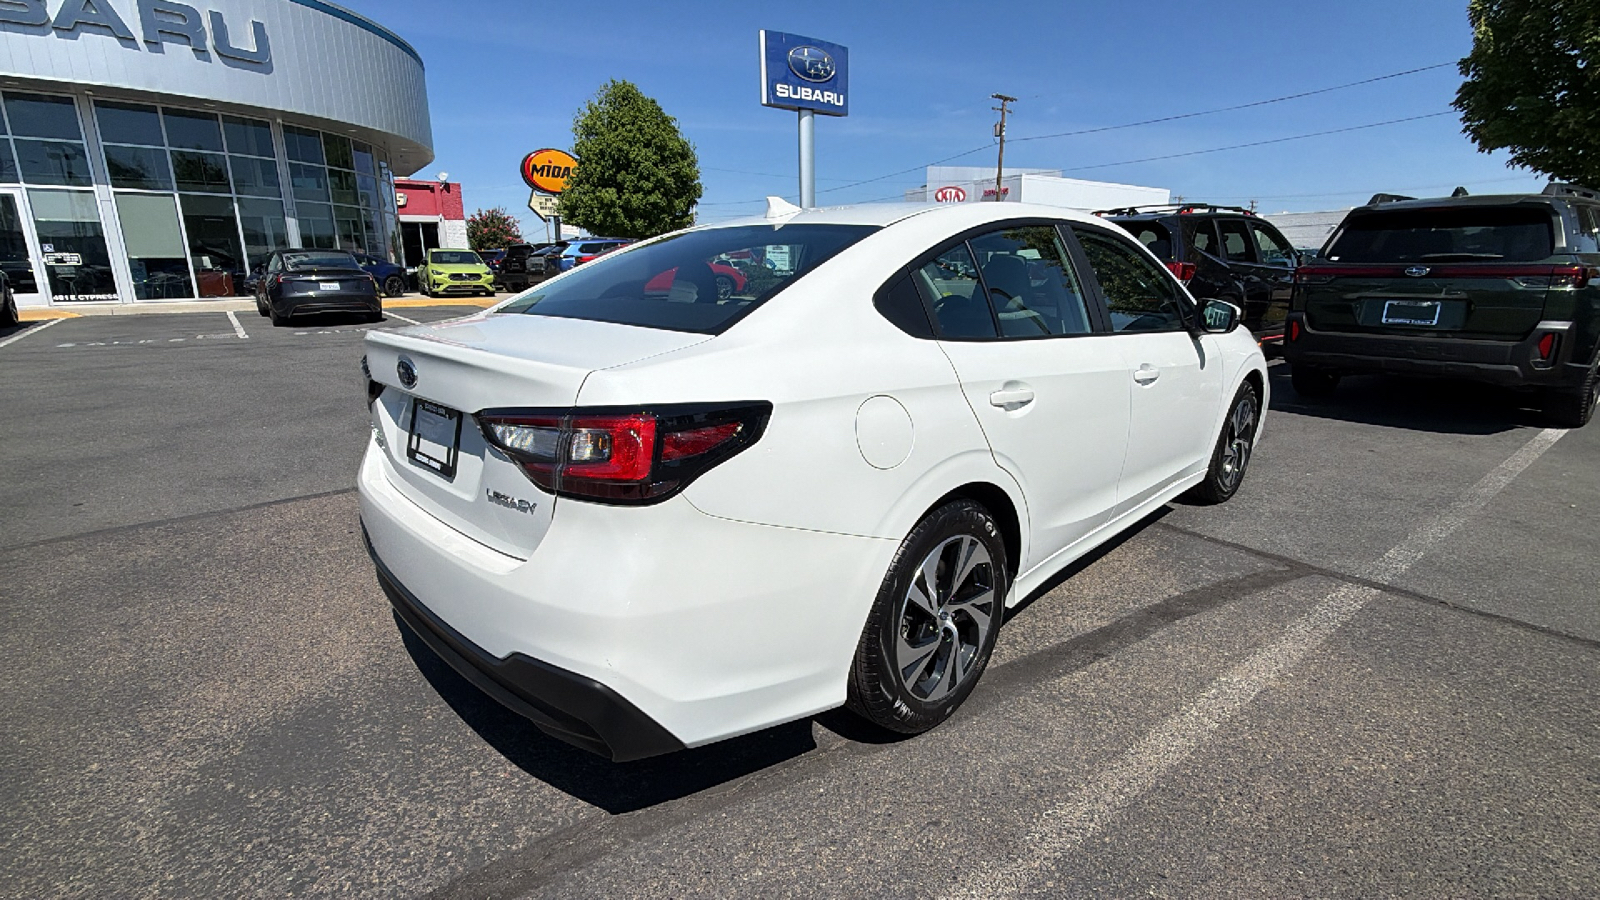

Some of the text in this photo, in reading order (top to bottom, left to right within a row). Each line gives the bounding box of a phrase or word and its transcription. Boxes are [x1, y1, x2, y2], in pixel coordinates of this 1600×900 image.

[776, 83, 844, 106] SUBARU
[531, 163, 578, 178] MIDA
[78, 293, 119, 301] CYPRESS
[486, 488, 538, 515] LEGACY
